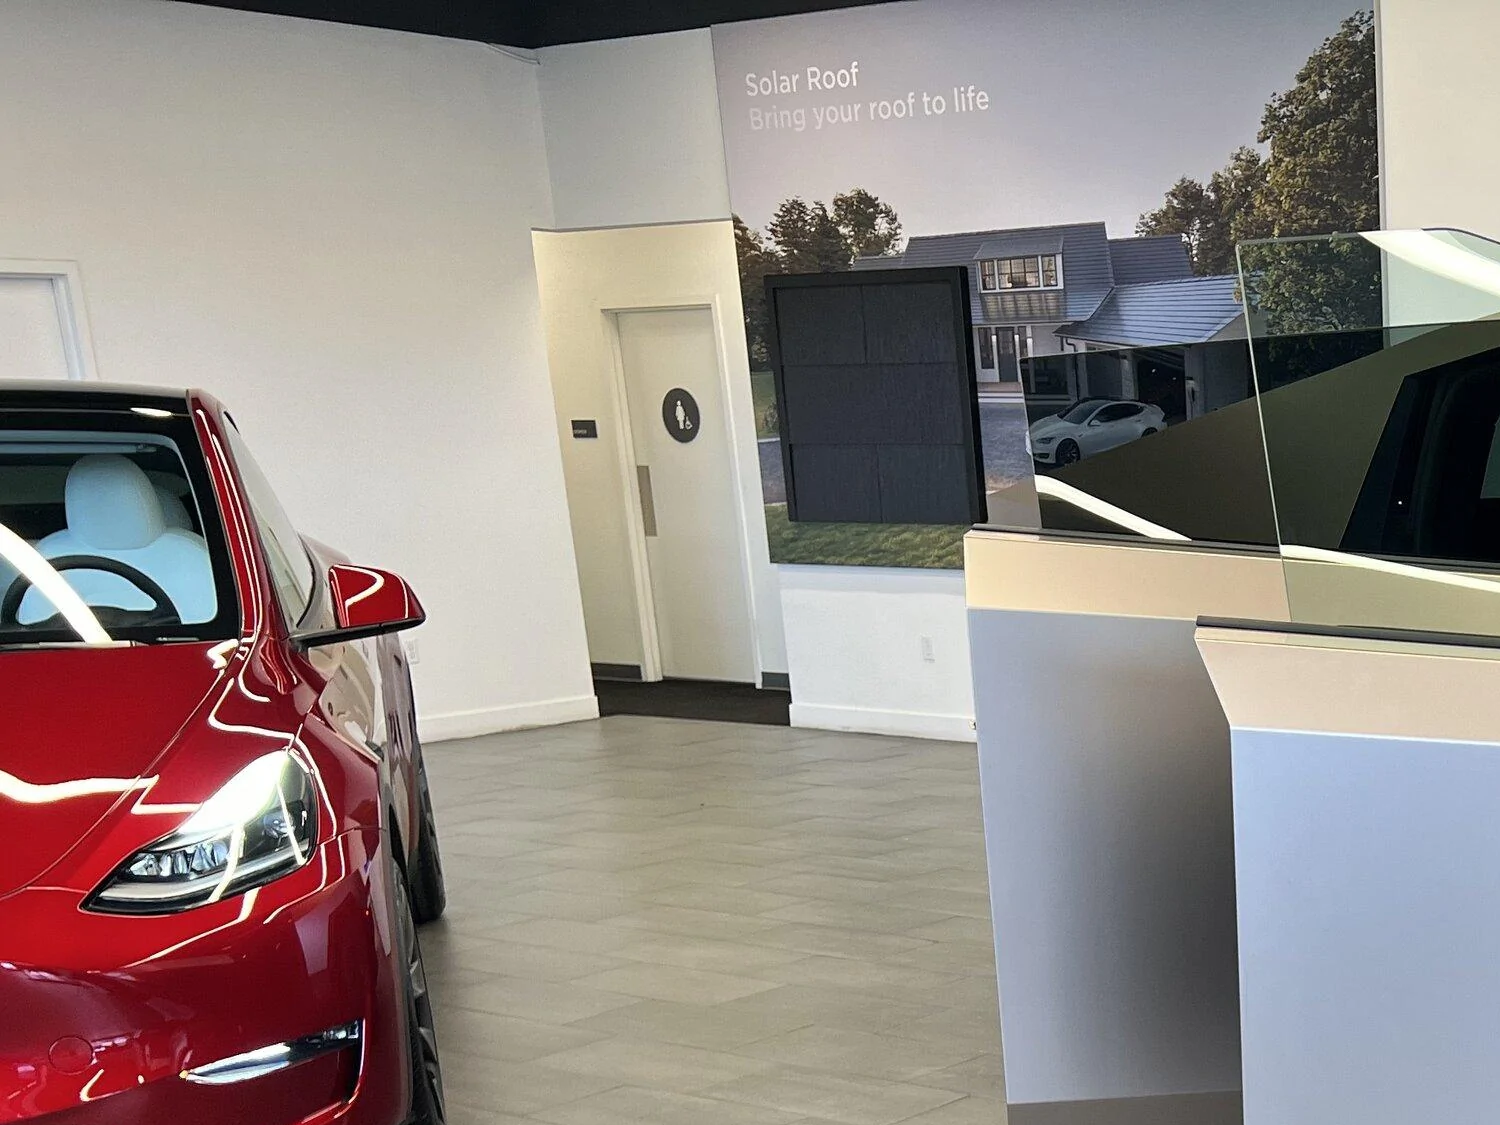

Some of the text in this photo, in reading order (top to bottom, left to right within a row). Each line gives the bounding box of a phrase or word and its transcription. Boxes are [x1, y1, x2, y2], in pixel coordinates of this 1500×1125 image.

[745, 61, 859, 97] Solar Roof
[749, 84, 990, 132] Bring your roof to life
